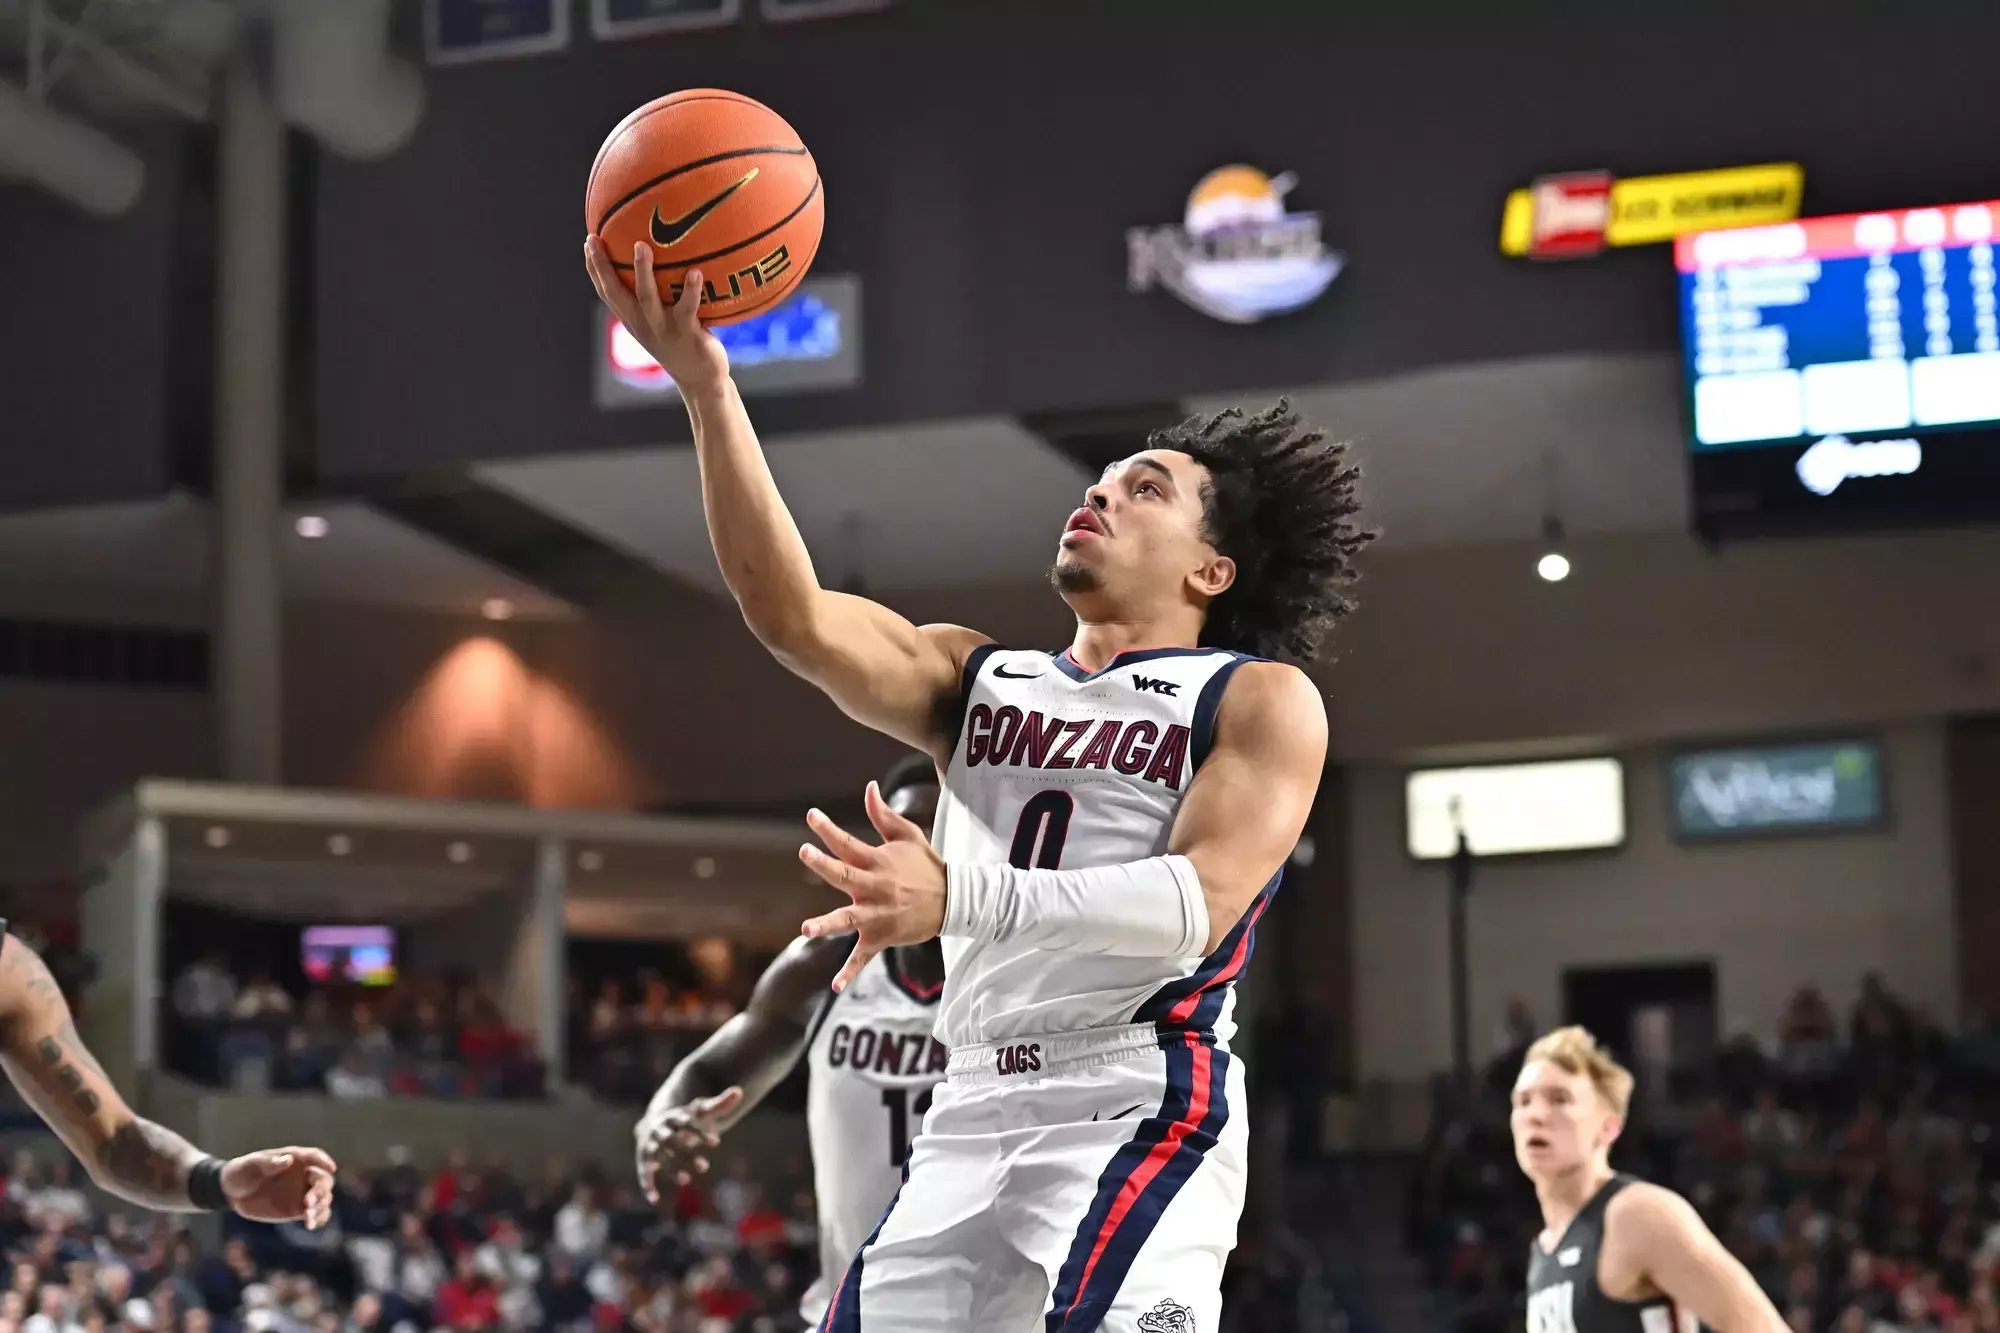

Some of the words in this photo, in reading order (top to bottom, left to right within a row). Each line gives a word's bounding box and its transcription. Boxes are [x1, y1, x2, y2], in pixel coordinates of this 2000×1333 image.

[1132, 674, 1181, 698] WCC
[966, 703, 1190, 791] GONZAGA
[1009, 790, 1073, 871] 0
[996, 1043, 1041, 1076] ZAGS
[882, 1088, 932, 1168] 1
